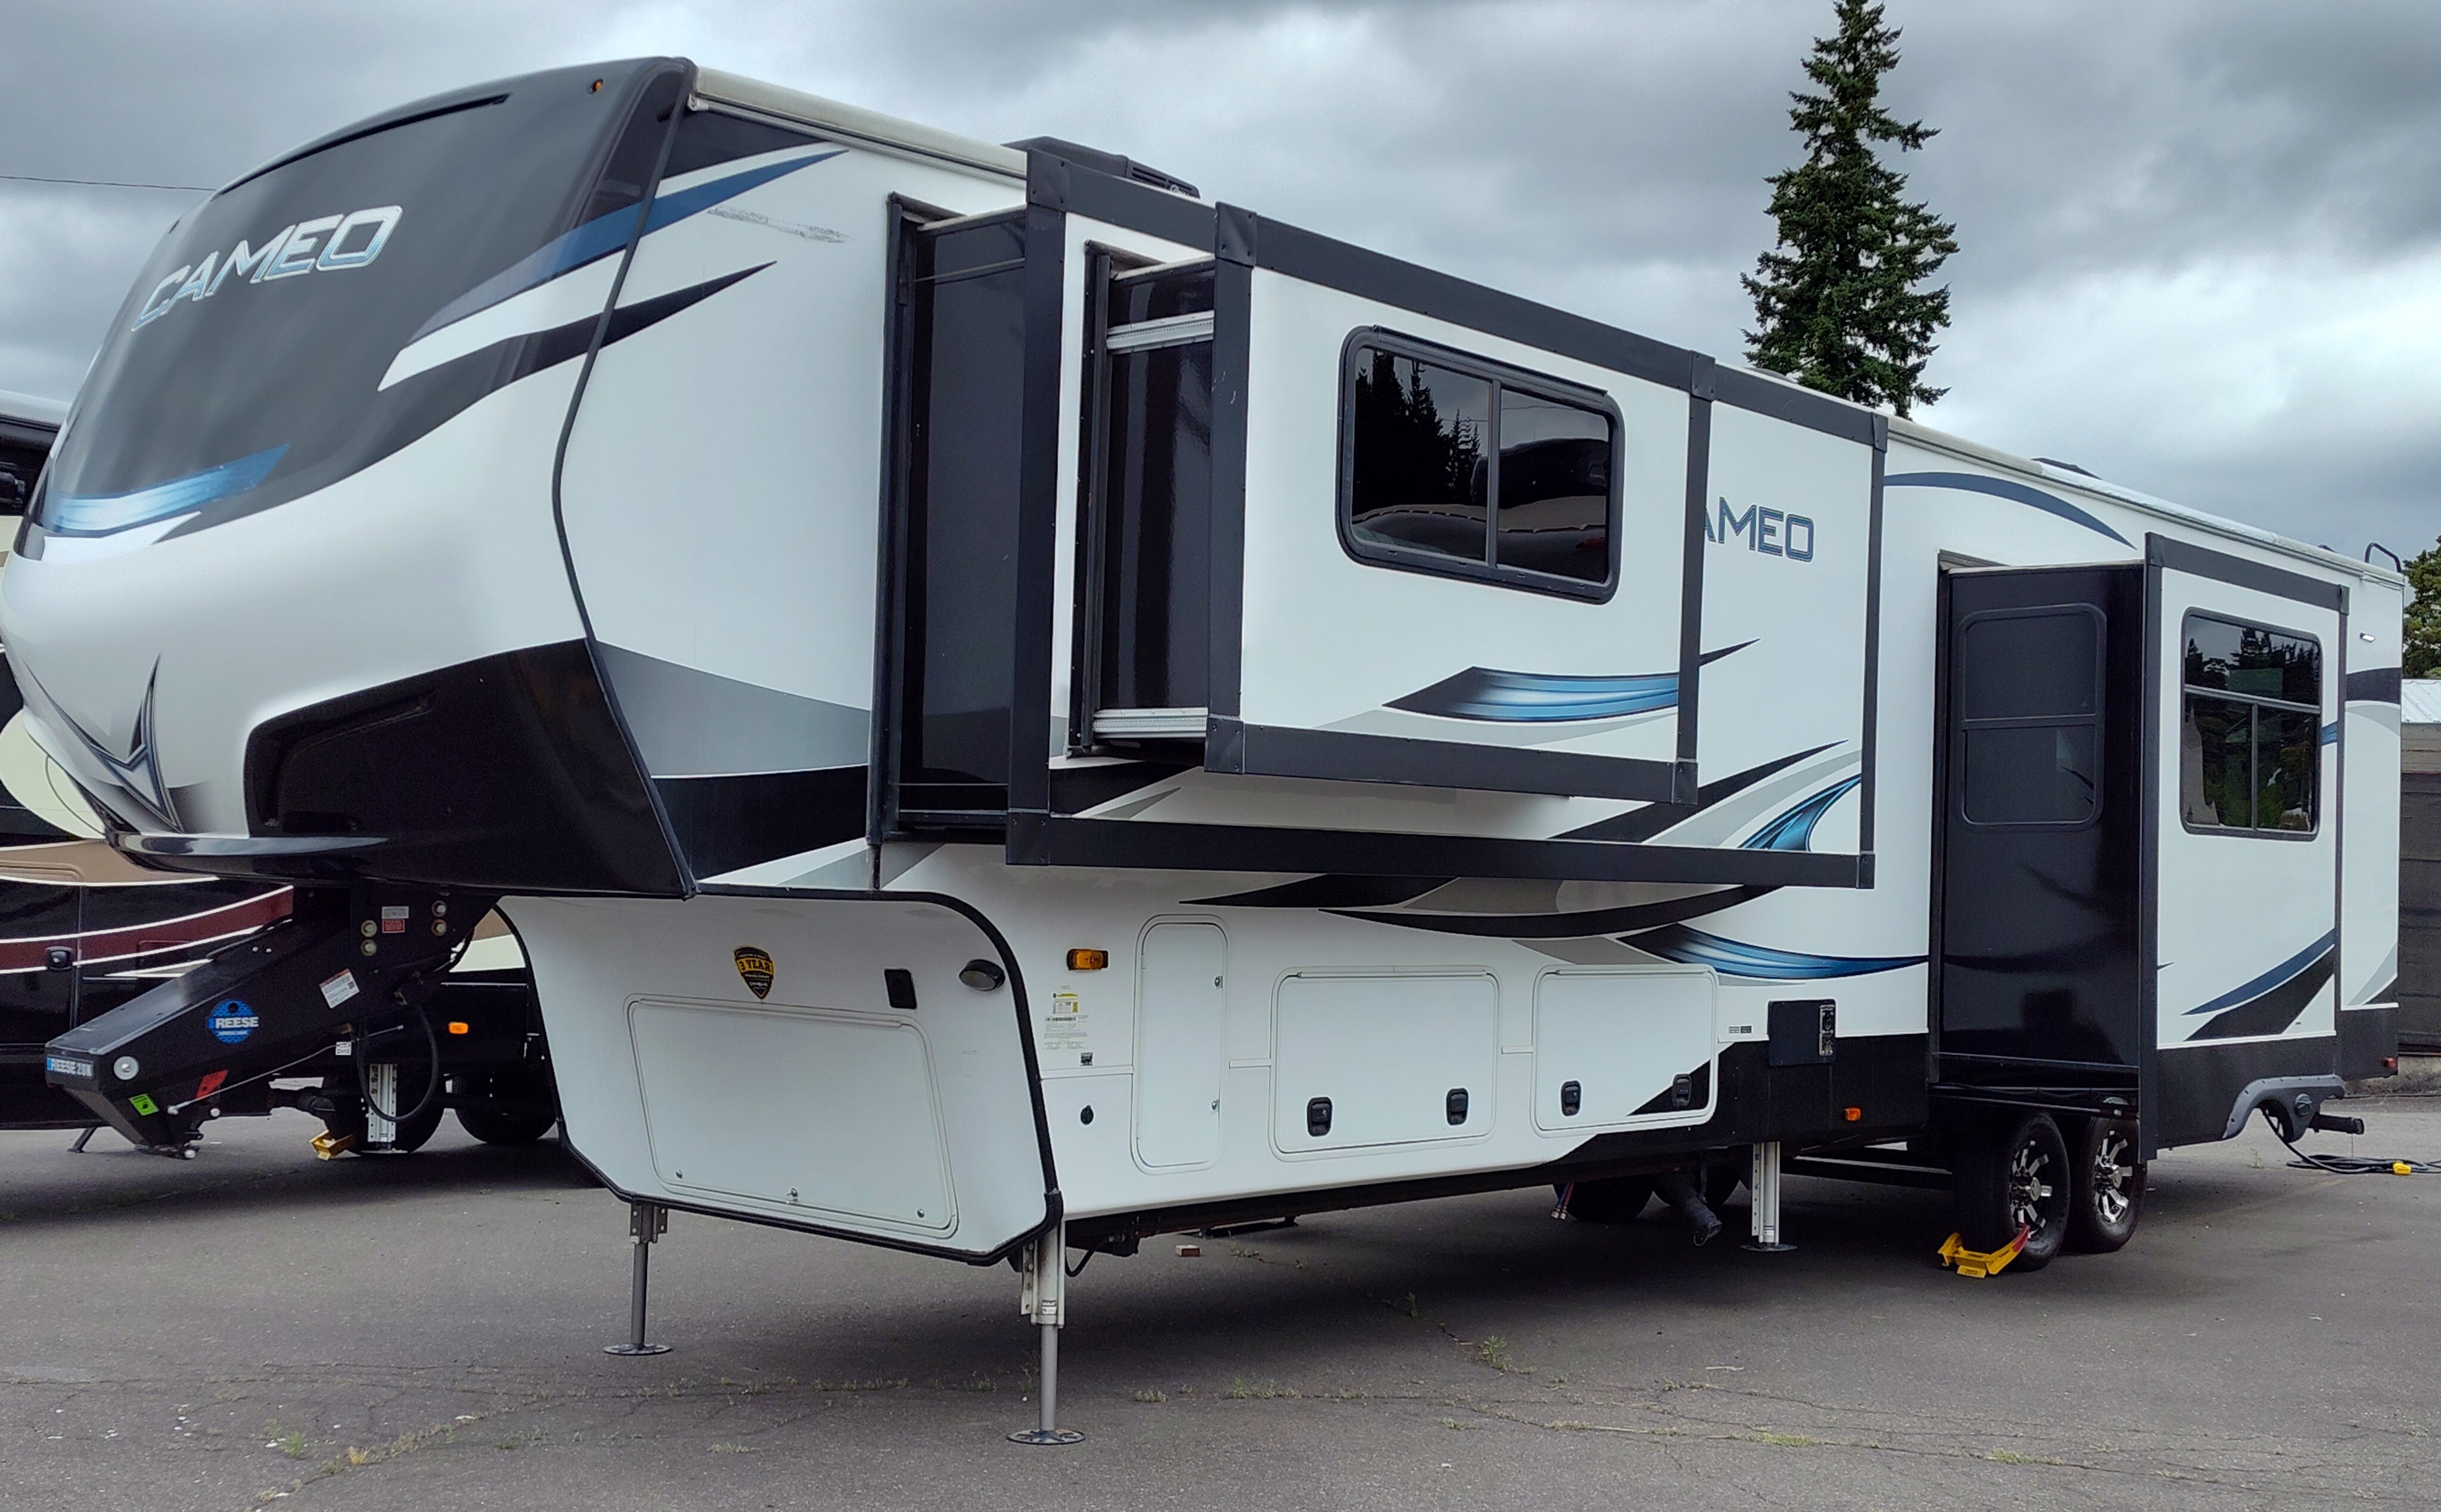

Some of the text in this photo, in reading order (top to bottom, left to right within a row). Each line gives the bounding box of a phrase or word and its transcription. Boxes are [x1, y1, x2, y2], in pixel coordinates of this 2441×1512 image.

[131, 205, 403, 332] CAMEO
[1704, 496, 1814, 563] MEO
[739, 959, 771, 973] 3 YEAR
[215, 1016, 259, 1029] REESE
[51, 1058, 76, 1075] REESE
